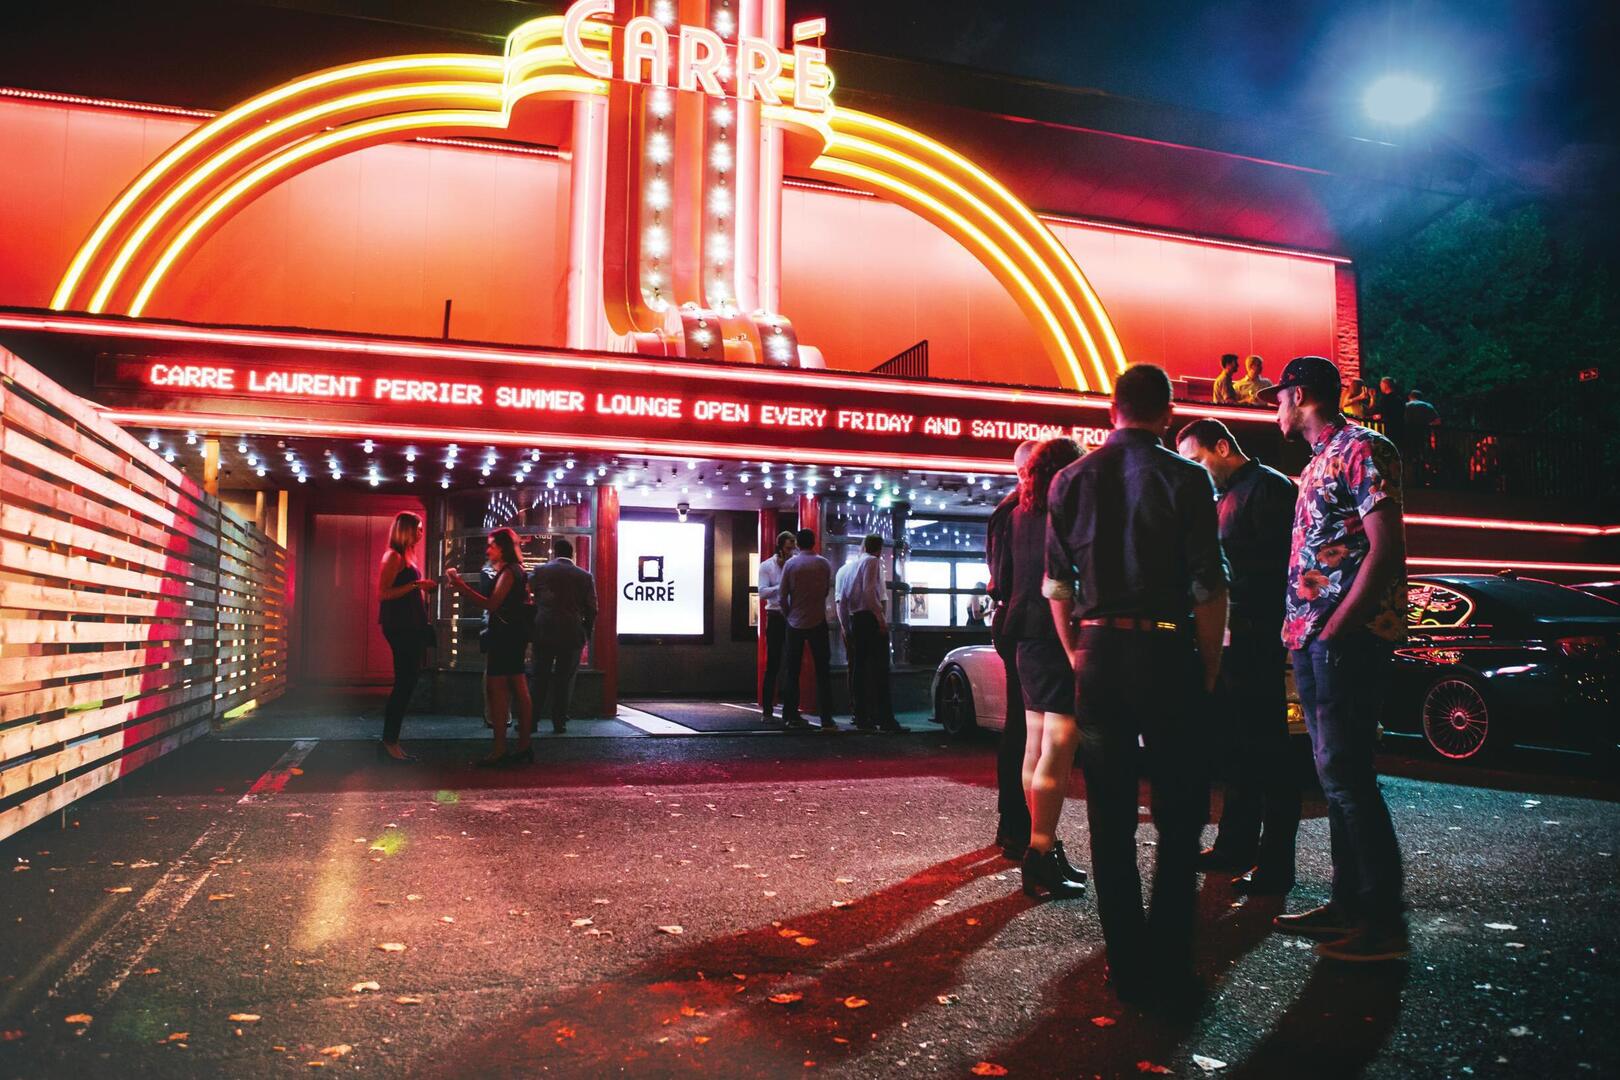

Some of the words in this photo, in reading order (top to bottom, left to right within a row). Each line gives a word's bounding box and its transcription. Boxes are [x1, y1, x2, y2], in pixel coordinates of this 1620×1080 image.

[562, 0, 827, 112] CARRÉ
[149, 363, 234, 390] CARRE
[248, 369, 362, 398] LAURENT
[374, 378, 484, 406] PERRIER
[495, 386, 585, 412] SUMMER
[596, 393, 682, 418] LOUNGE
[694, 400, 750, 423] OPEN
[760, 405, 827, 428] EVERY
[837, 410, 914, 434] FRIDAY
[924, 417, 961, 437] AND
[971, 420, 1063, 442] SATURDAY
[1072, 426, 1110, 446] FRO
[623, 580, 675, 602] CARRÉ
